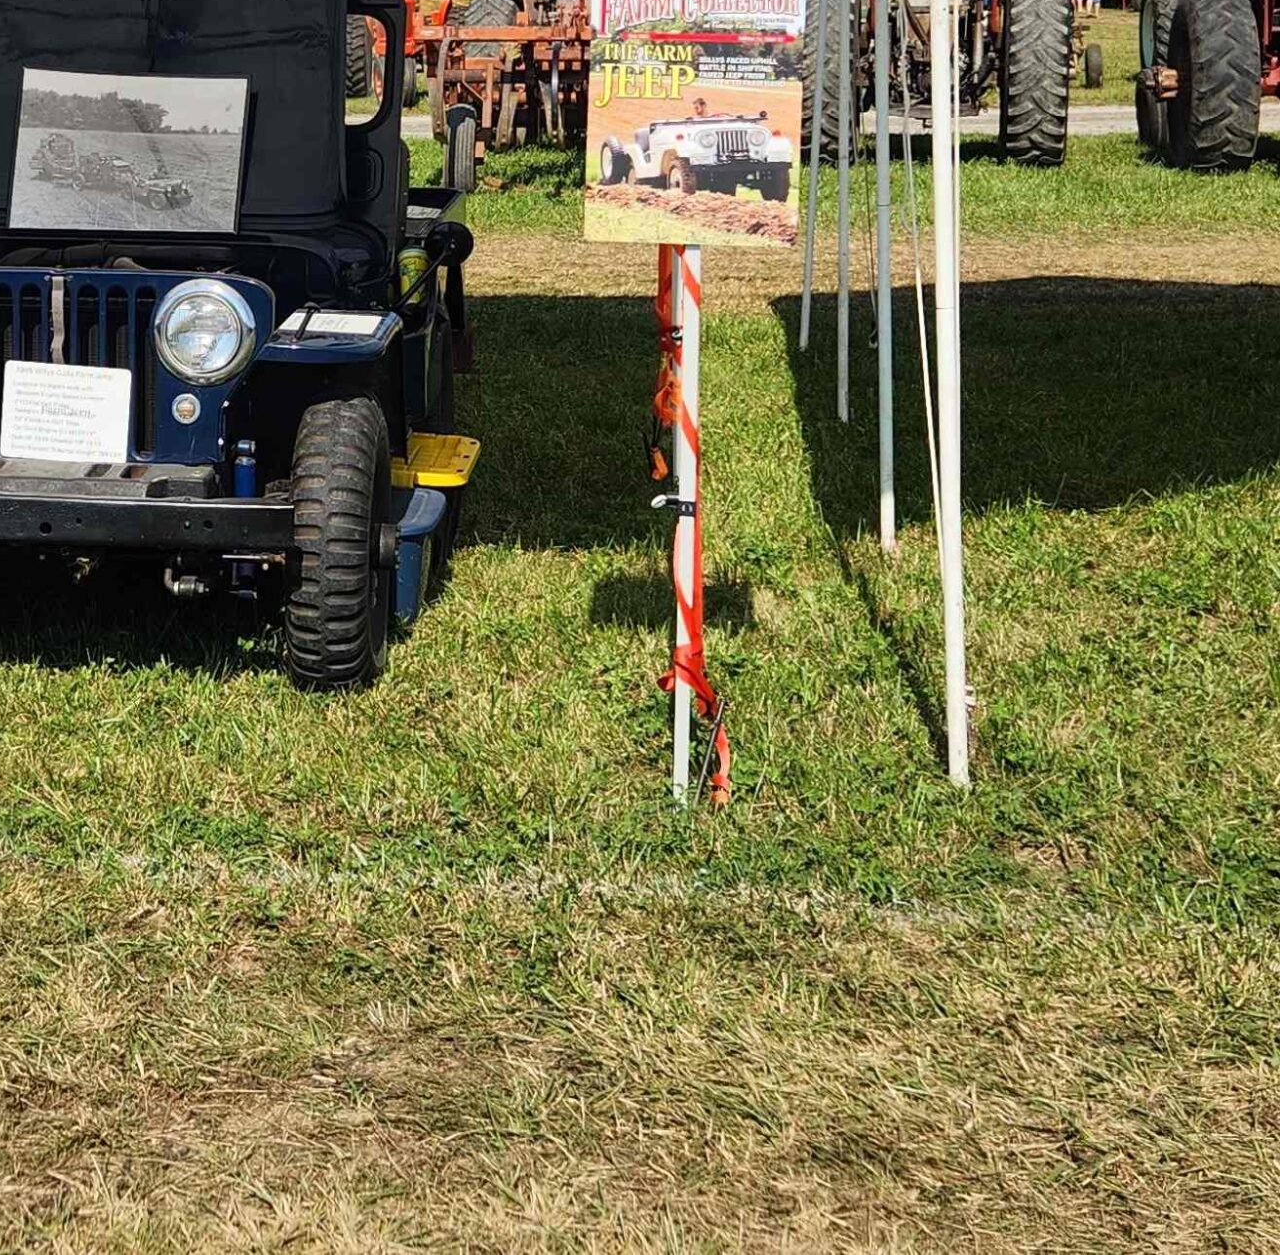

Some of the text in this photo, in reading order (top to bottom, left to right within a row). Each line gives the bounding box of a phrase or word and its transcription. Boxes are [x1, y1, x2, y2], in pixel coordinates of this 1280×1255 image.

[603, 44, 693, 61] THE FARM
[594, 63, 696, 108] JEEP
